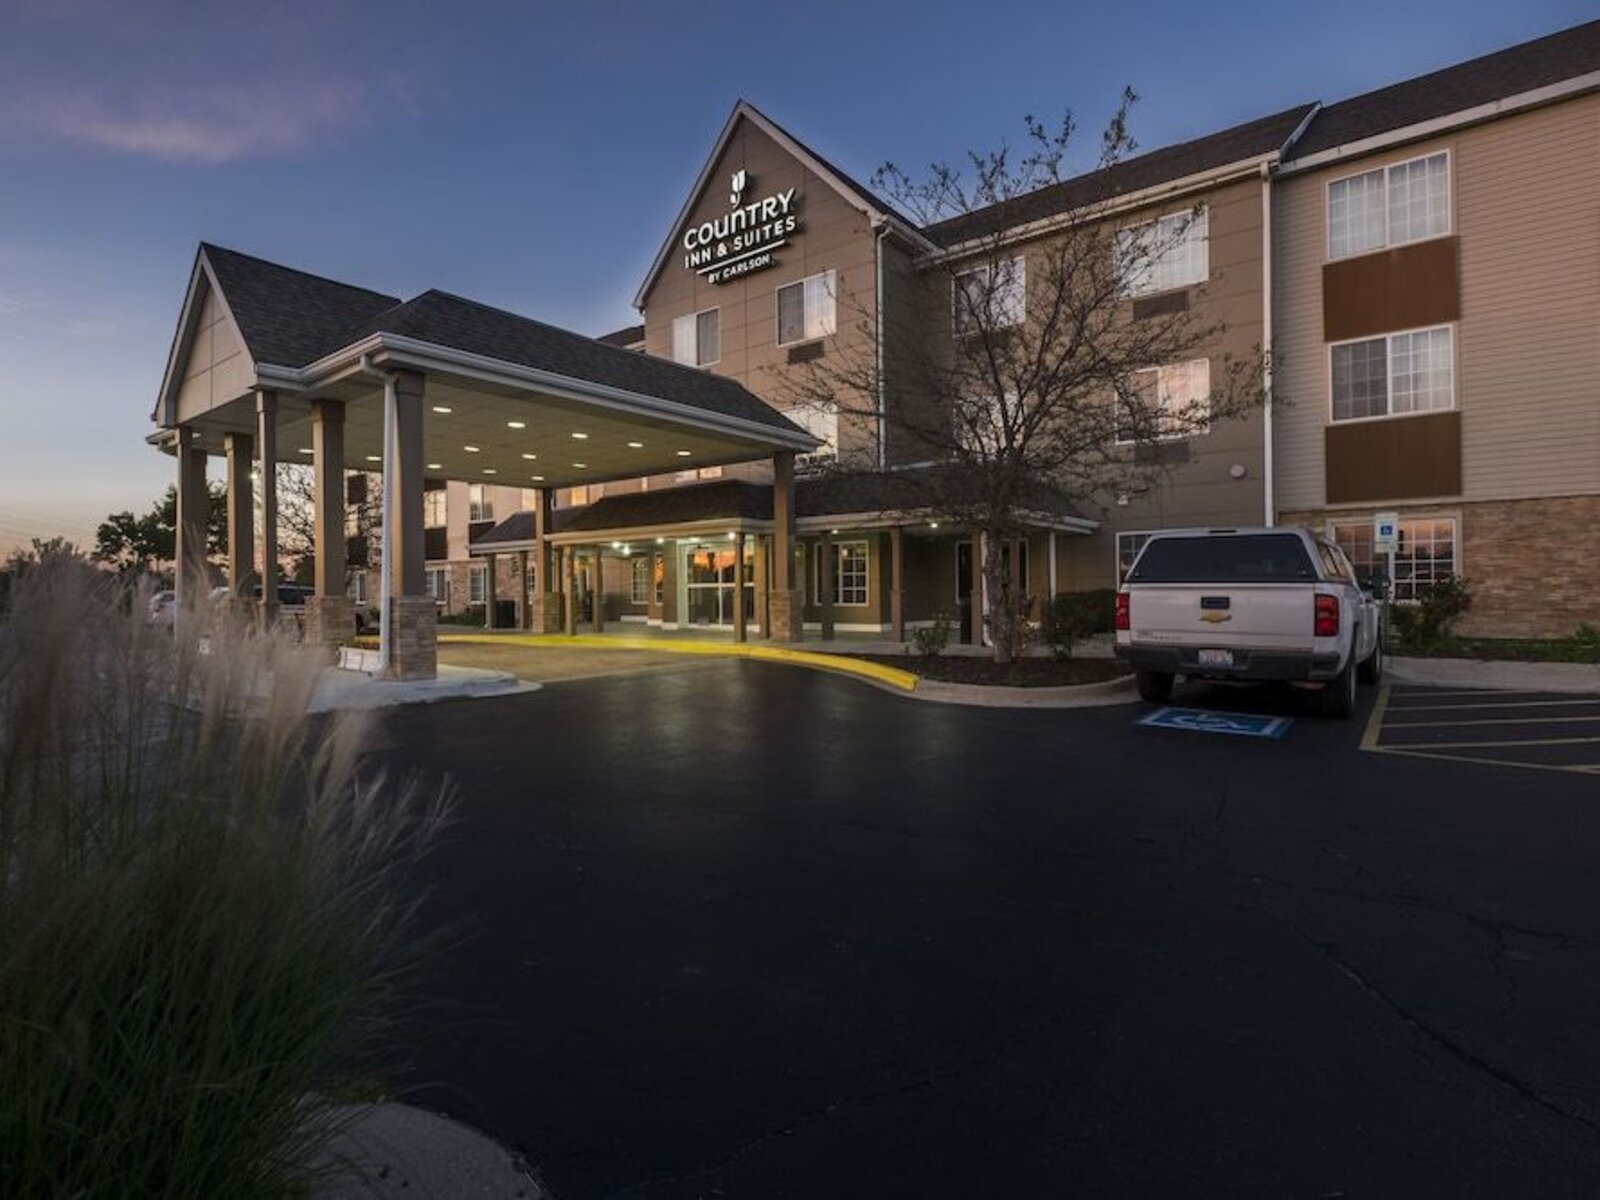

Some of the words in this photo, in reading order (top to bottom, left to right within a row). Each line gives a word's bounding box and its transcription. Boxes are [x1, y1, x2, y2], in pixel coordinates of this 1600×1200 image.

[683, 187, 794, 250] COUNTRY
[684, 247, 711, 269] INN
[717, 242, 728, 257] &
[733, 216, 796, 251] SUITES
[708, 271, 721, 283] BY
[723, 254, 770, 278] CARLSON
